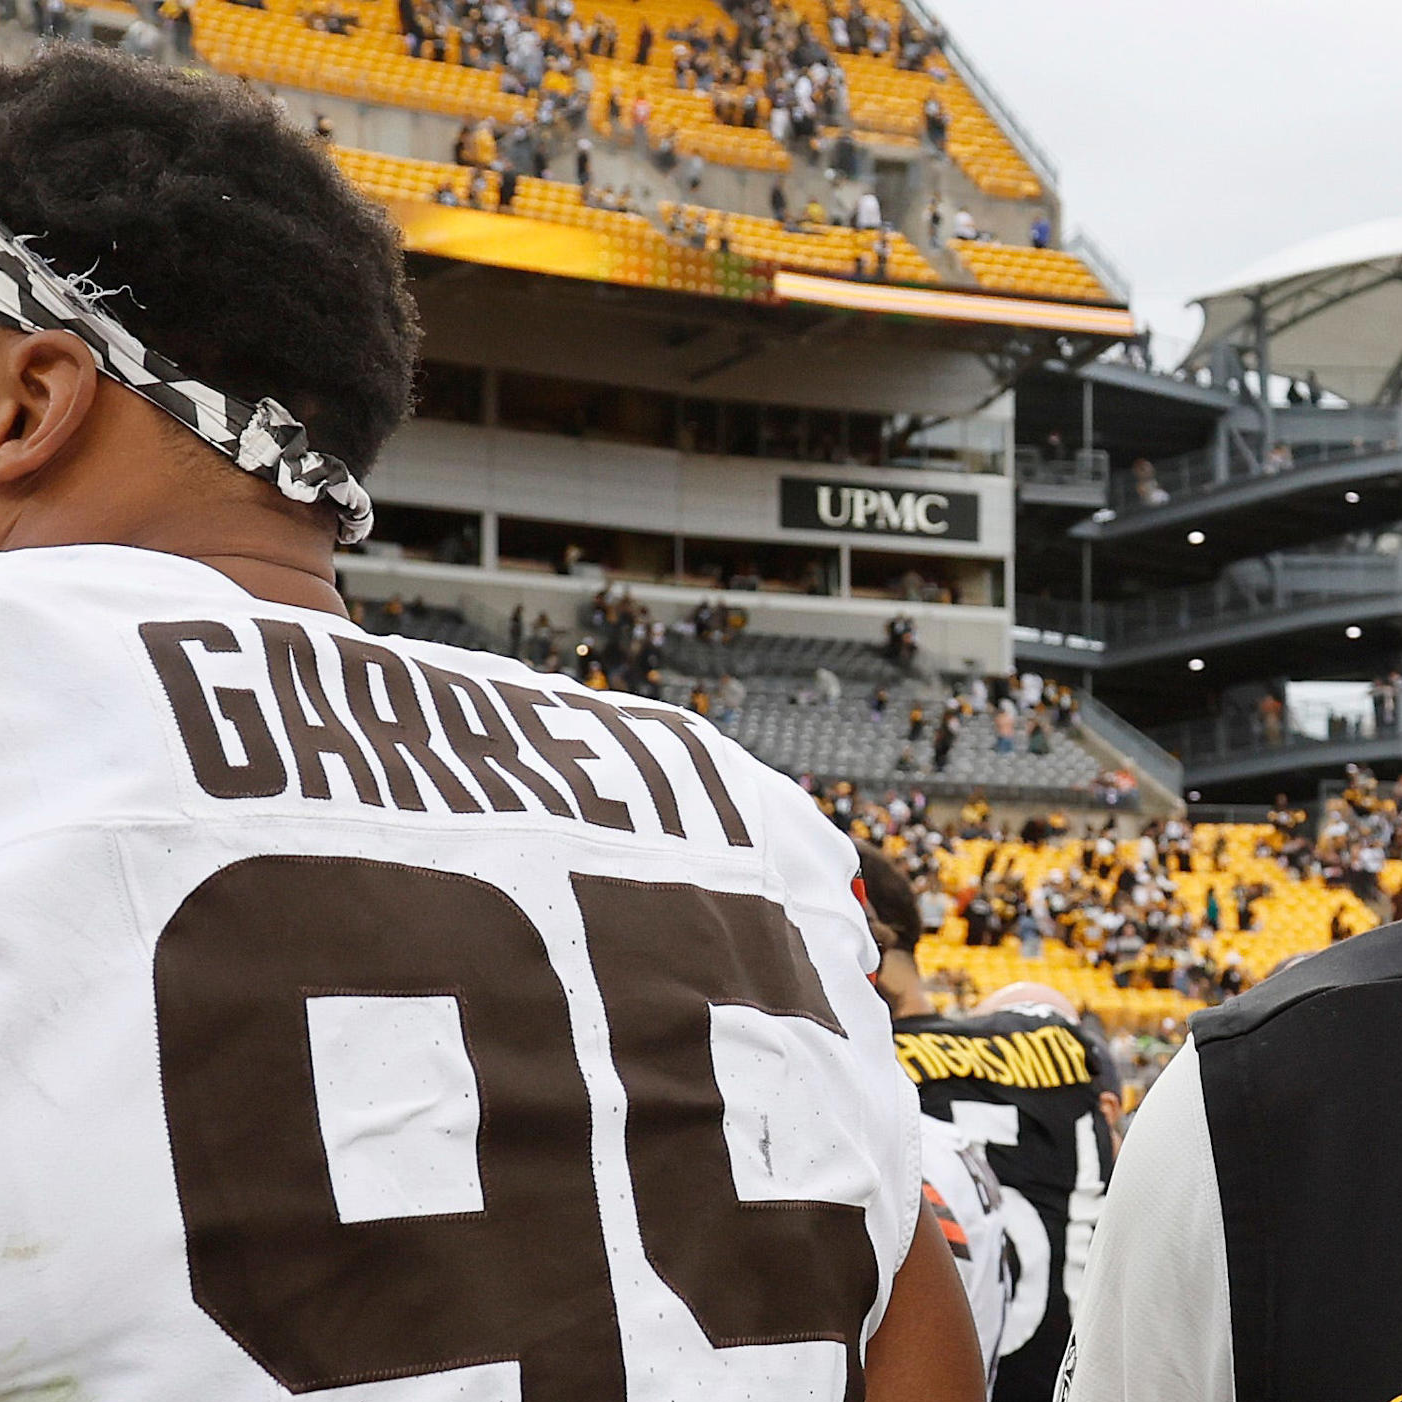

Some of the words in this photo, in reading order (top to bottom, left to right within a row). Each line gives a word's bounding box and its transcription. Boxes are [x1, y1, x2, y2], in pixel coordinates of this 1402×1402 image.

[816, 485, 949, 535] UPMC
[139, 617, 754, 848] GARRETT
[894, 1025, 1092, 1088] HIGHSMITH
